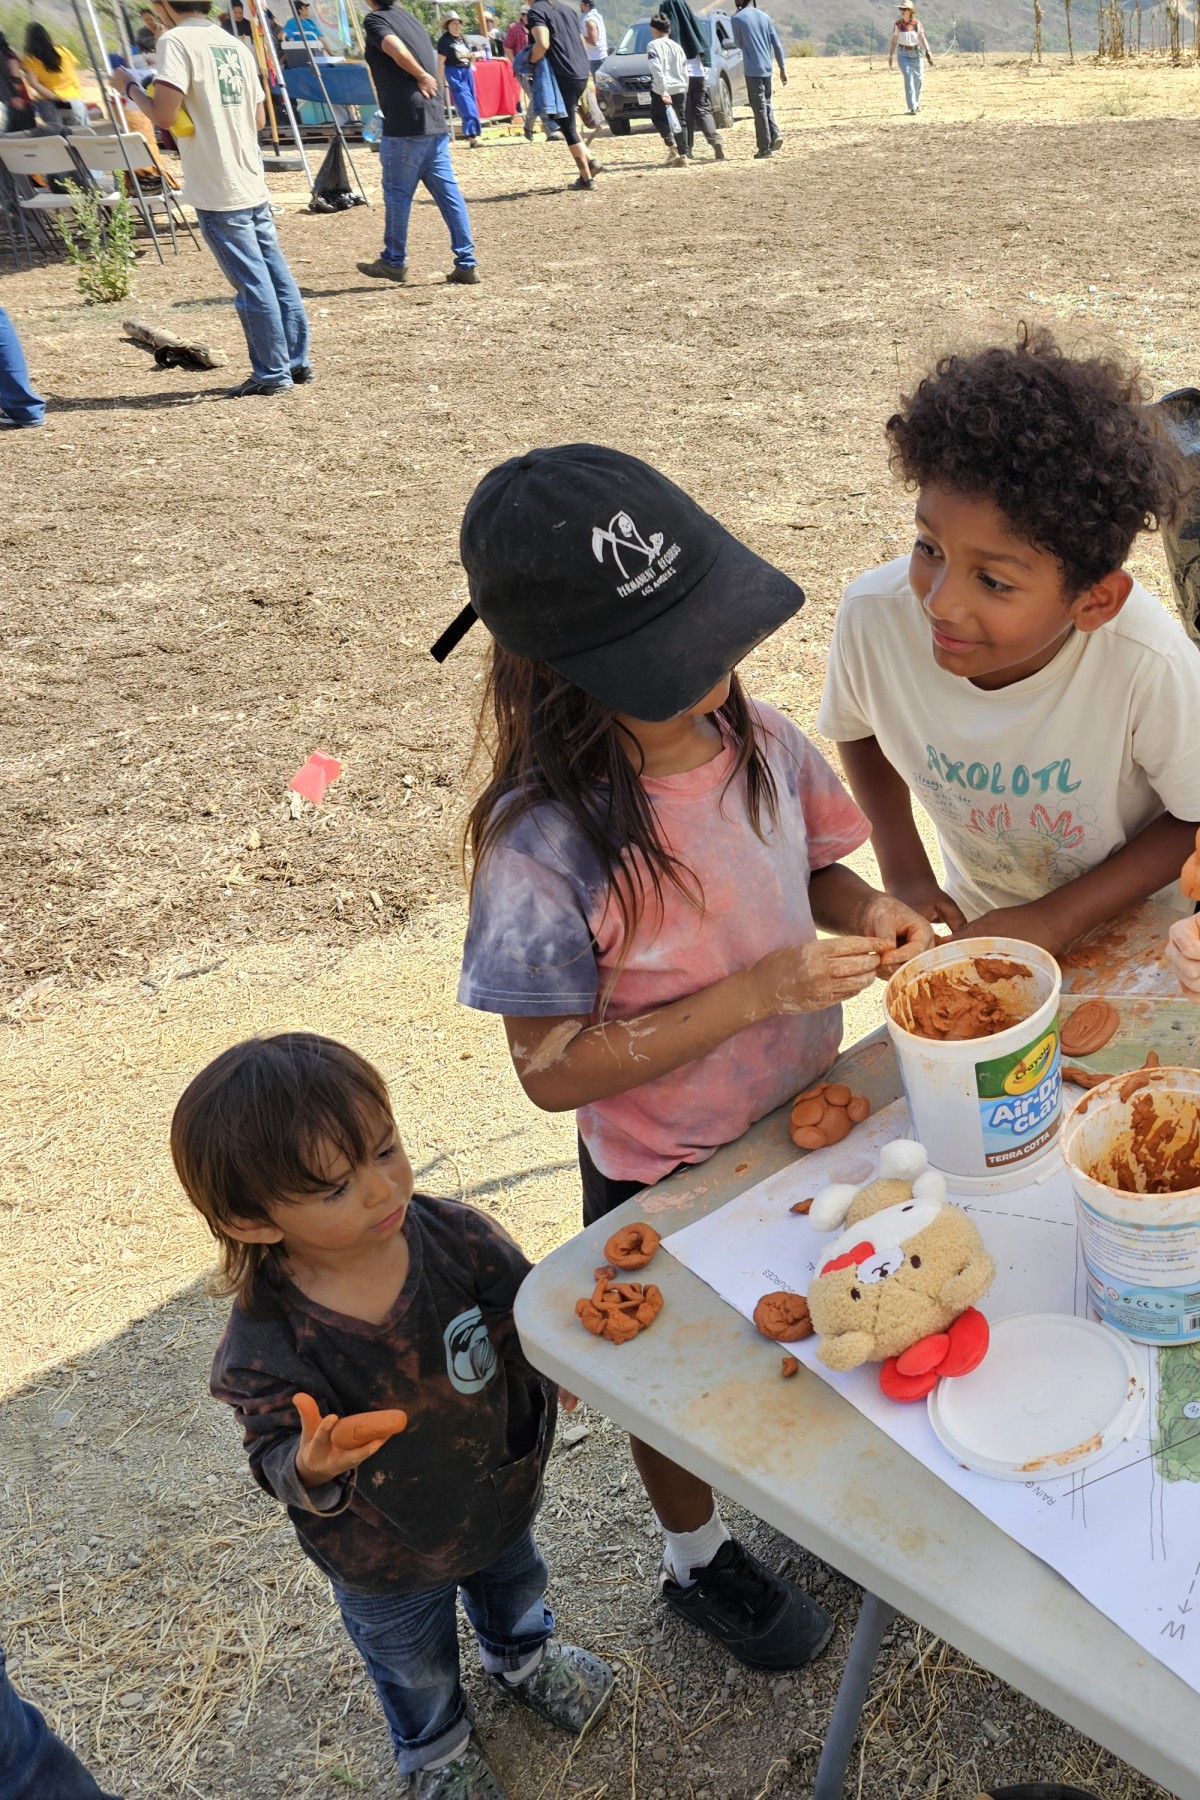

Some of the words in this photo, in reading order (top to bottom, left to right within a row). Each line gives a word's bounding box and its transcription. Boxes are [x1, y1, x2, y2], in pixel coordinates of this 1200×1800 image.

[616, 567, 656, 598] PERMANENT
[657, 543, 682, 571] RECORDS
[641, 585, 654, 596] LOS
[927, 744, 1082, 797] AXOLOTL
[988, 1149, 1024, 1164] TERRA
[1024, 1131, 1051, 1155] COTTA
[1033, 1486, 1057, 1506] RAIN
